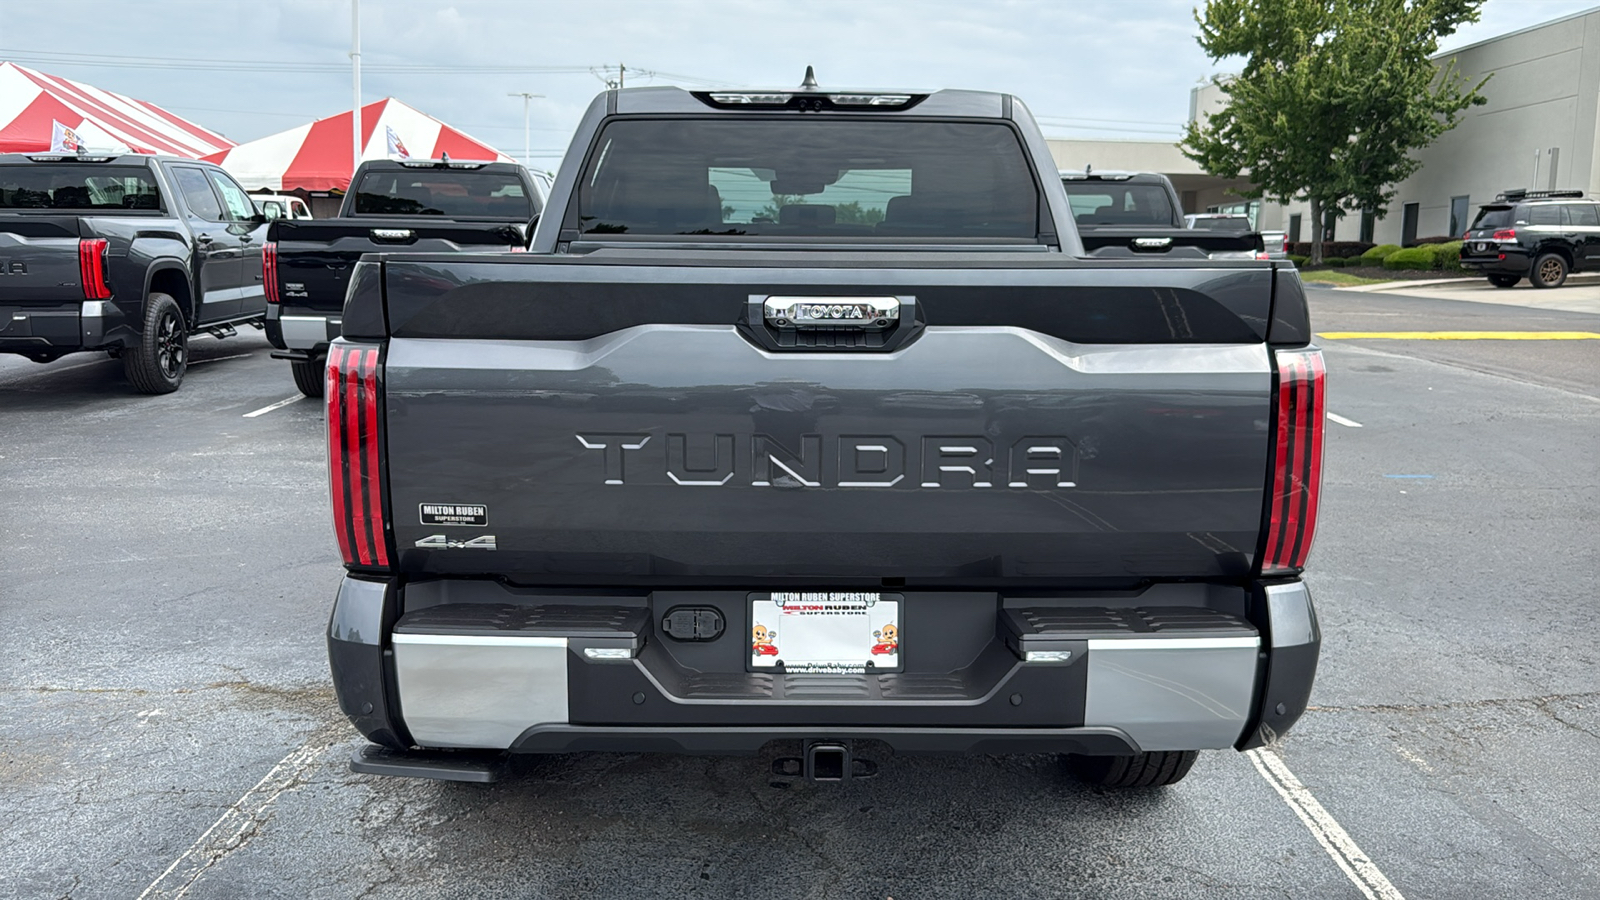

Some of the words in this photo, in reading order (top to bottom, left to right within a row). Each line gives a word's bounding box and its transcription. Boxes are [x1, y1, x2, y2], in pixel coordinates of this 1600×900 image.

[801, 304, 863, 319] TOYOTA
[575, 433, 1078, 488] TUNDRA
[423, 505, 455, 515] MILTON
[456, 506, 484, 516] RUBEN
[771, 592, 800, 601] MILTON
[801, 592, 828, 601] RUBEN
[829, 592, 880, 601] SUPERSTORE
